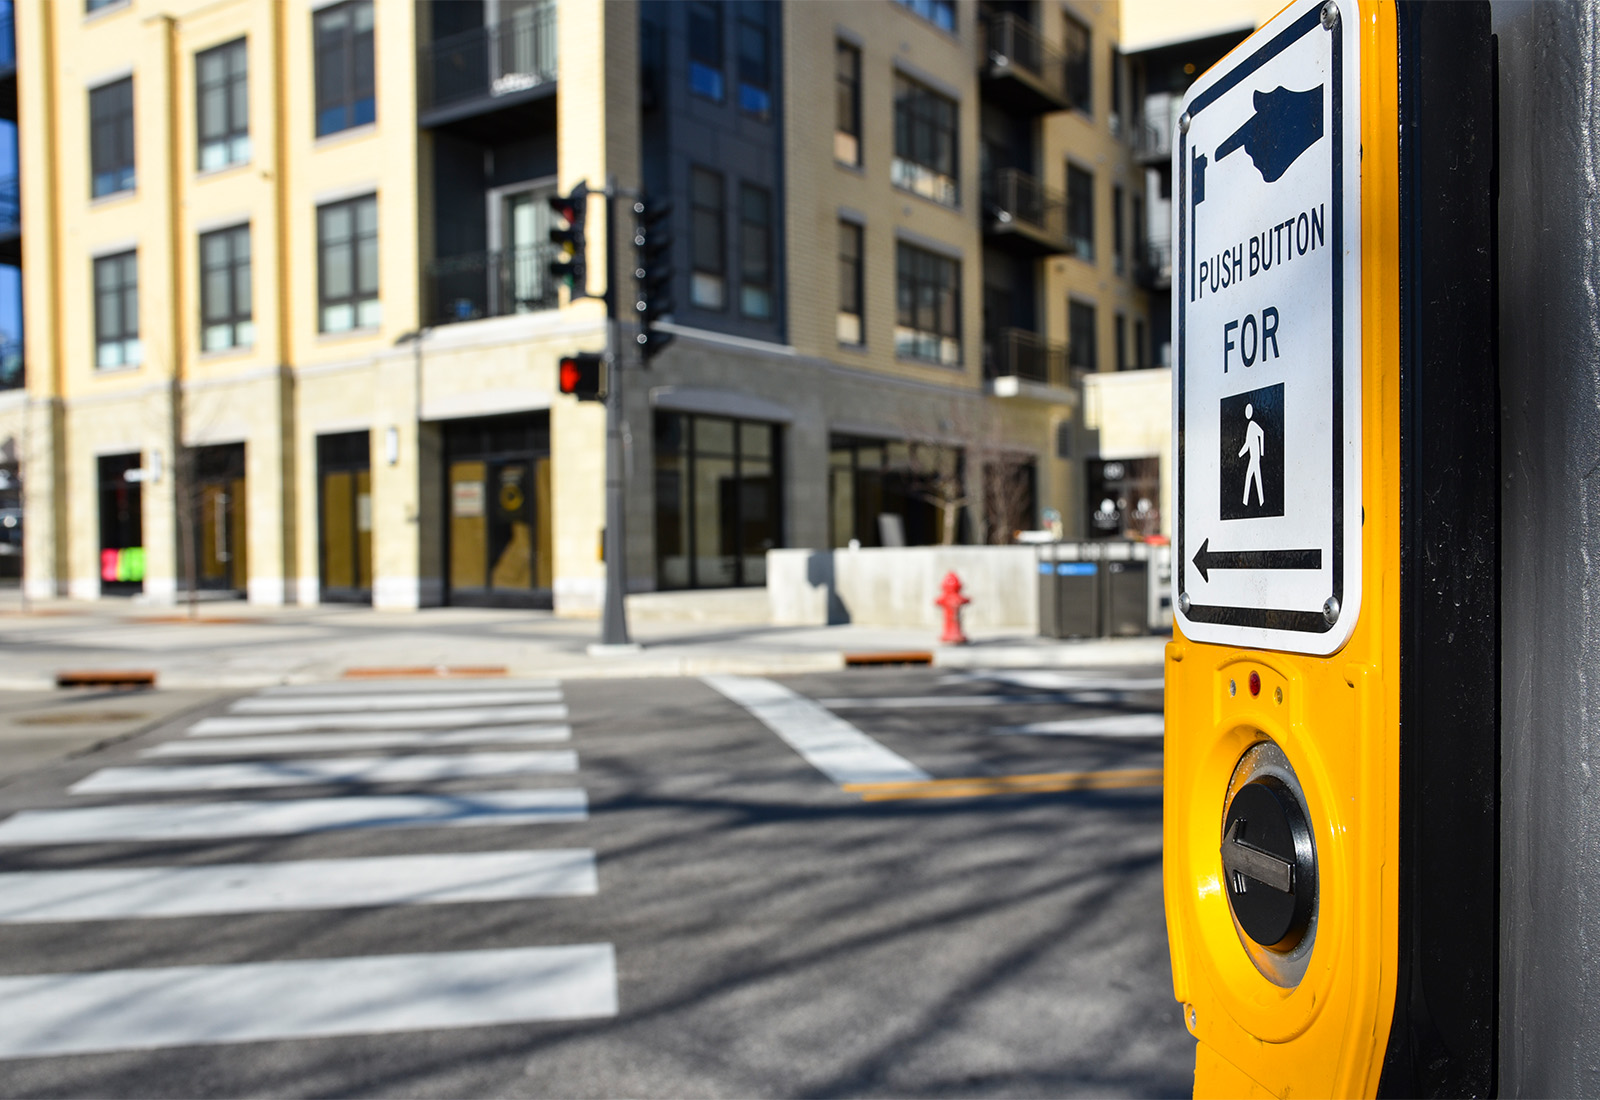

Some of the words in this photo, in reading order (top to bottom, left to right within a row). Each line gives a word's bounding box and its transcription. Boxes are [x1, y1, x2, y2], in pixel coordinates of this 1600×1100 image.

[1200, 243, 1243, 299] PUSH
[1249, 203, 1325, 278] BUTTON
[1224, 306, 1280, 374] FOR
